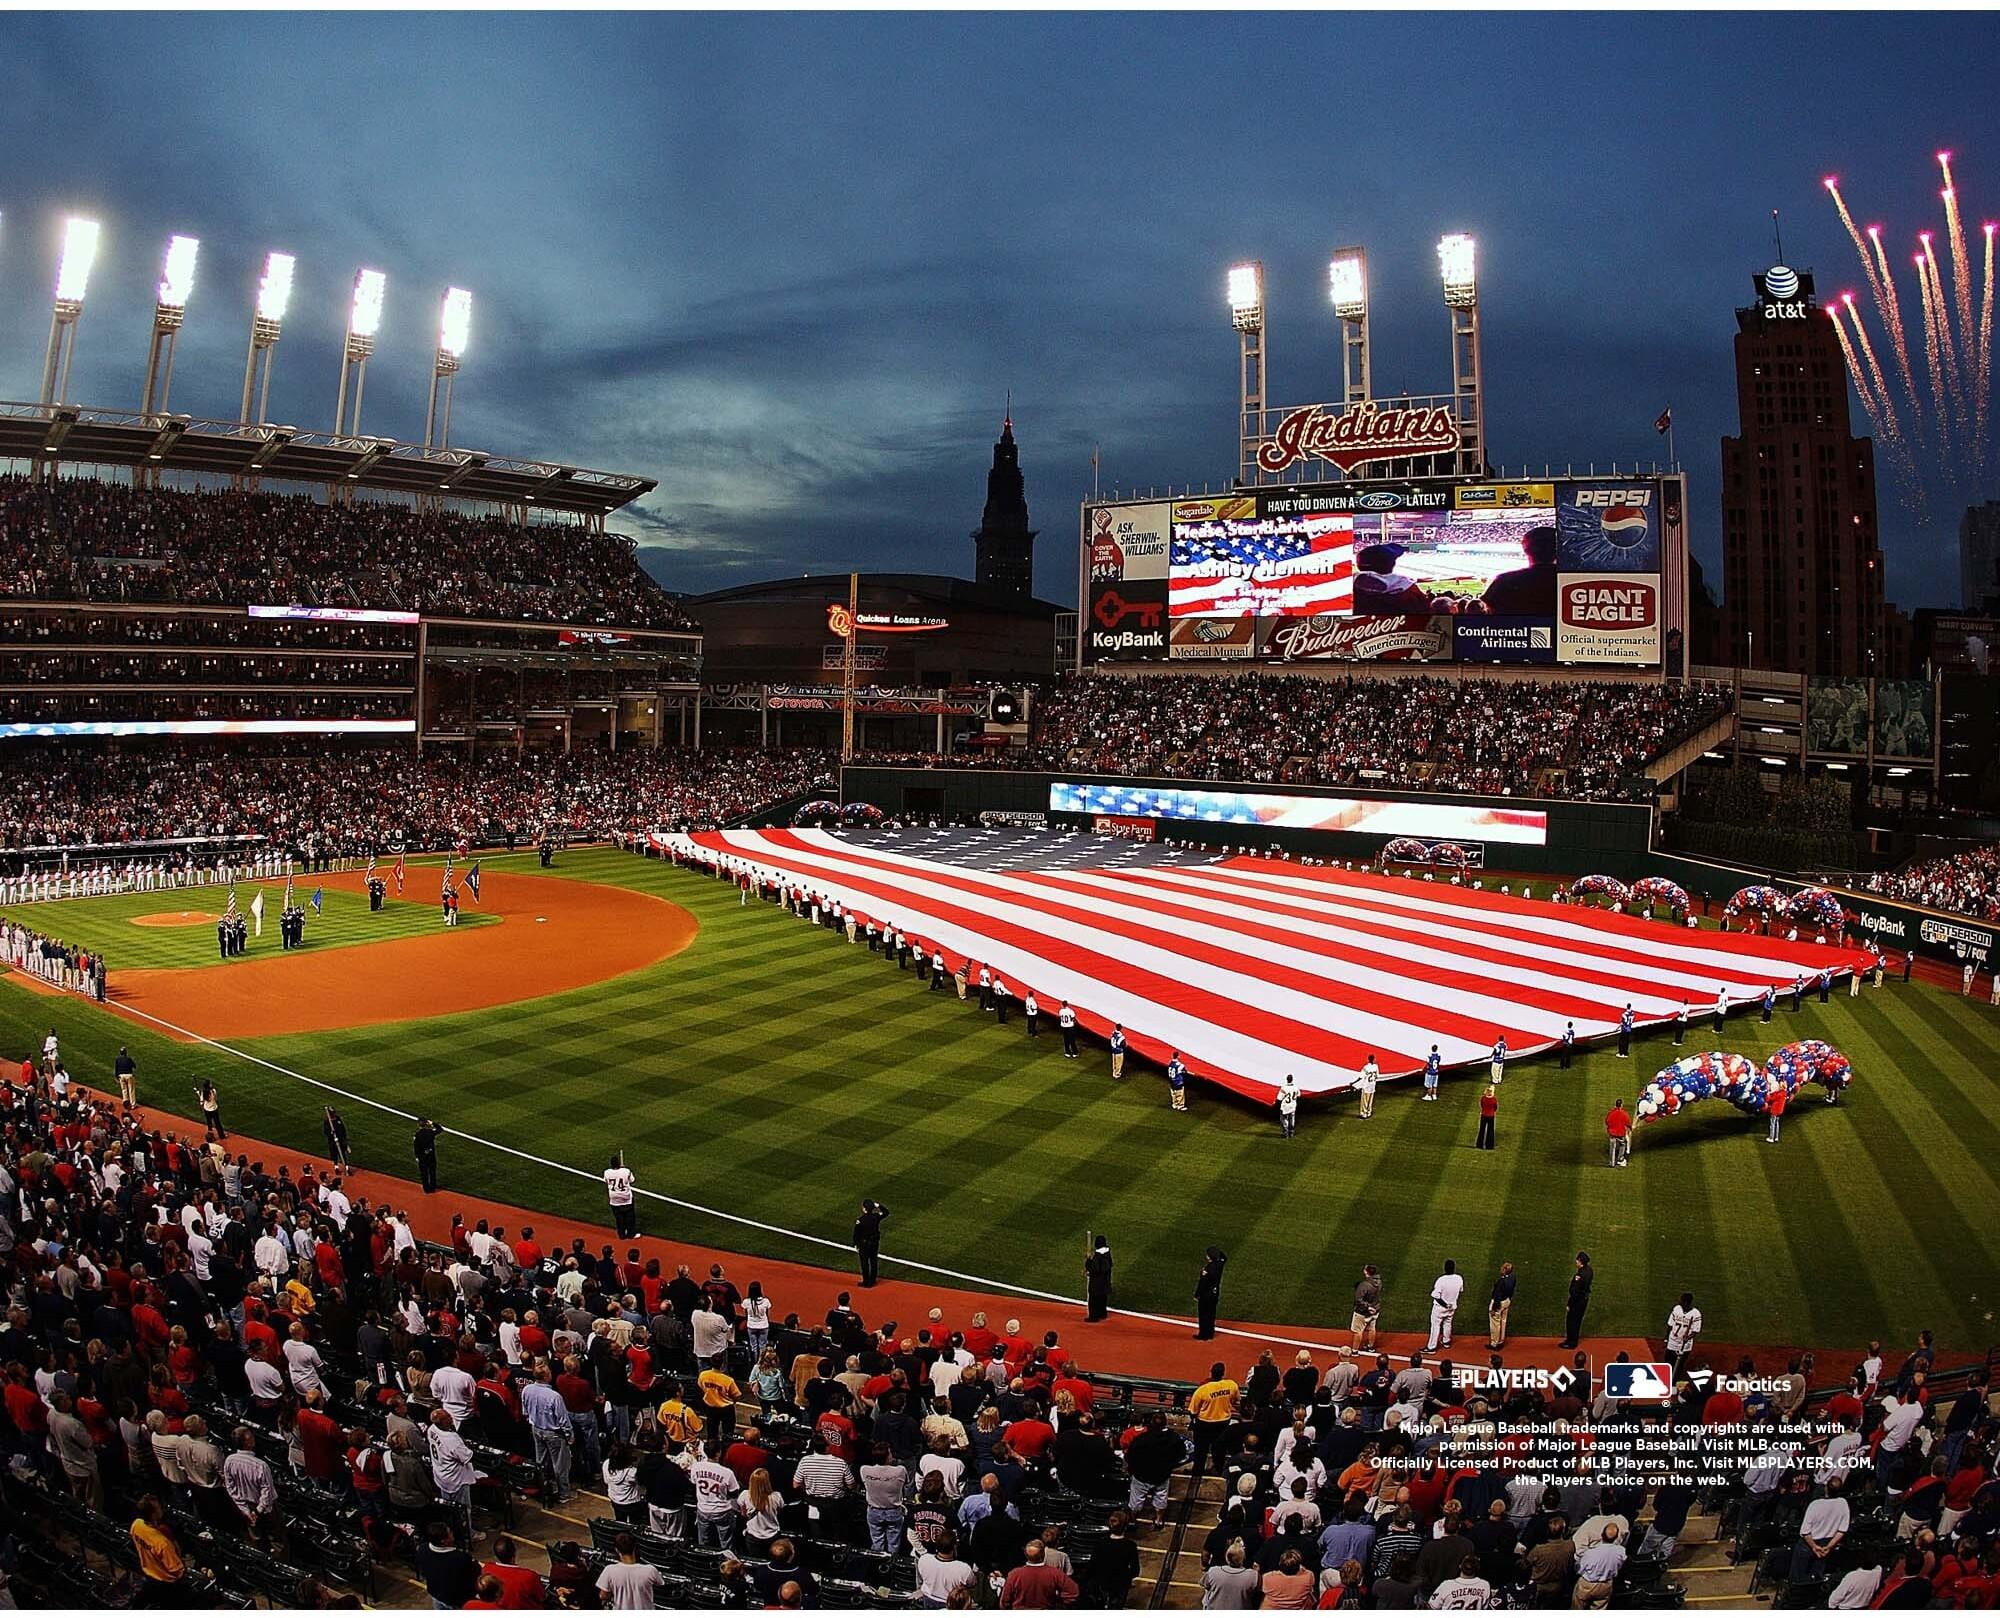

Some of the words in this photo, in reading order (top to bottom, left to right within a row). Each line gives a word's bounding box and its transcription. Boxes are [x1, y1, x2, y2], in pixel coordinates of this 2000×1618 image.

[1765, 301, 1807, 319] at&t
[1257, 401, 1460, 473] Indians
[1267, 500, 1292, 513] HAVE
[1293, 498, 1311, 511] YOU
[1313, 497, 1347, 510] DRIVEN
[1347, 497, 1356, 508] A
[1367, 494, 1394, 507] Ford
[1406, 493, 1447, 507] LATELY?
[1575, 489, 1651, 507] PEPSI
[1175, 504, 1215, 518] Sugardale
[1117, 522, 1134, 534] ASK
[1120, 532, 1161, 546] SHERWIN-
[1125, 544, 1165, 557] WILLIAMS
[1569, 589, 1647, 605] GIANT
[893, 615, 920, 624] Loans
[1572, 606, 1645, 622] EAGLE
[1275, 615, 1406, 660] Budweiser
[1457, 626, 1528, 637] Continental
[1093, 631, 1164, 651] KeyBank
[1362, 636, 1406, 656] American
[1480, 638, 1528, 649] Airlines
[1560, 635, 1596, 645] Official
[1598, 636, 1657, 647] supermarket
[1175, 646, 1212, 657] Medical
[1214, 646, 1249, 657] Mutual
[1575, 648, 1585, 657] of
[1586, 648, 1602, 656] the
[1603, 648, 1642, 657] Indians.
[812, 687, 829, 695] Tribe
[784, 698, 825, 709] TOYOTA
[1111, 822, 1130, 834] State
[1131, 824, 1152, 835] Farm
[1861, 912, 1906, 937] KeyBank
[1926, 920, 1993, 948] POSTSEASON
[1971, 946, 1988, 962] FOX
[608, 1178, 626, 1192] 74
[543, 1262, 557, 1274] 24
[697, 1480, 721, 1498] 24
[1451, 1587, 1486, 1599] SIZEMORE
